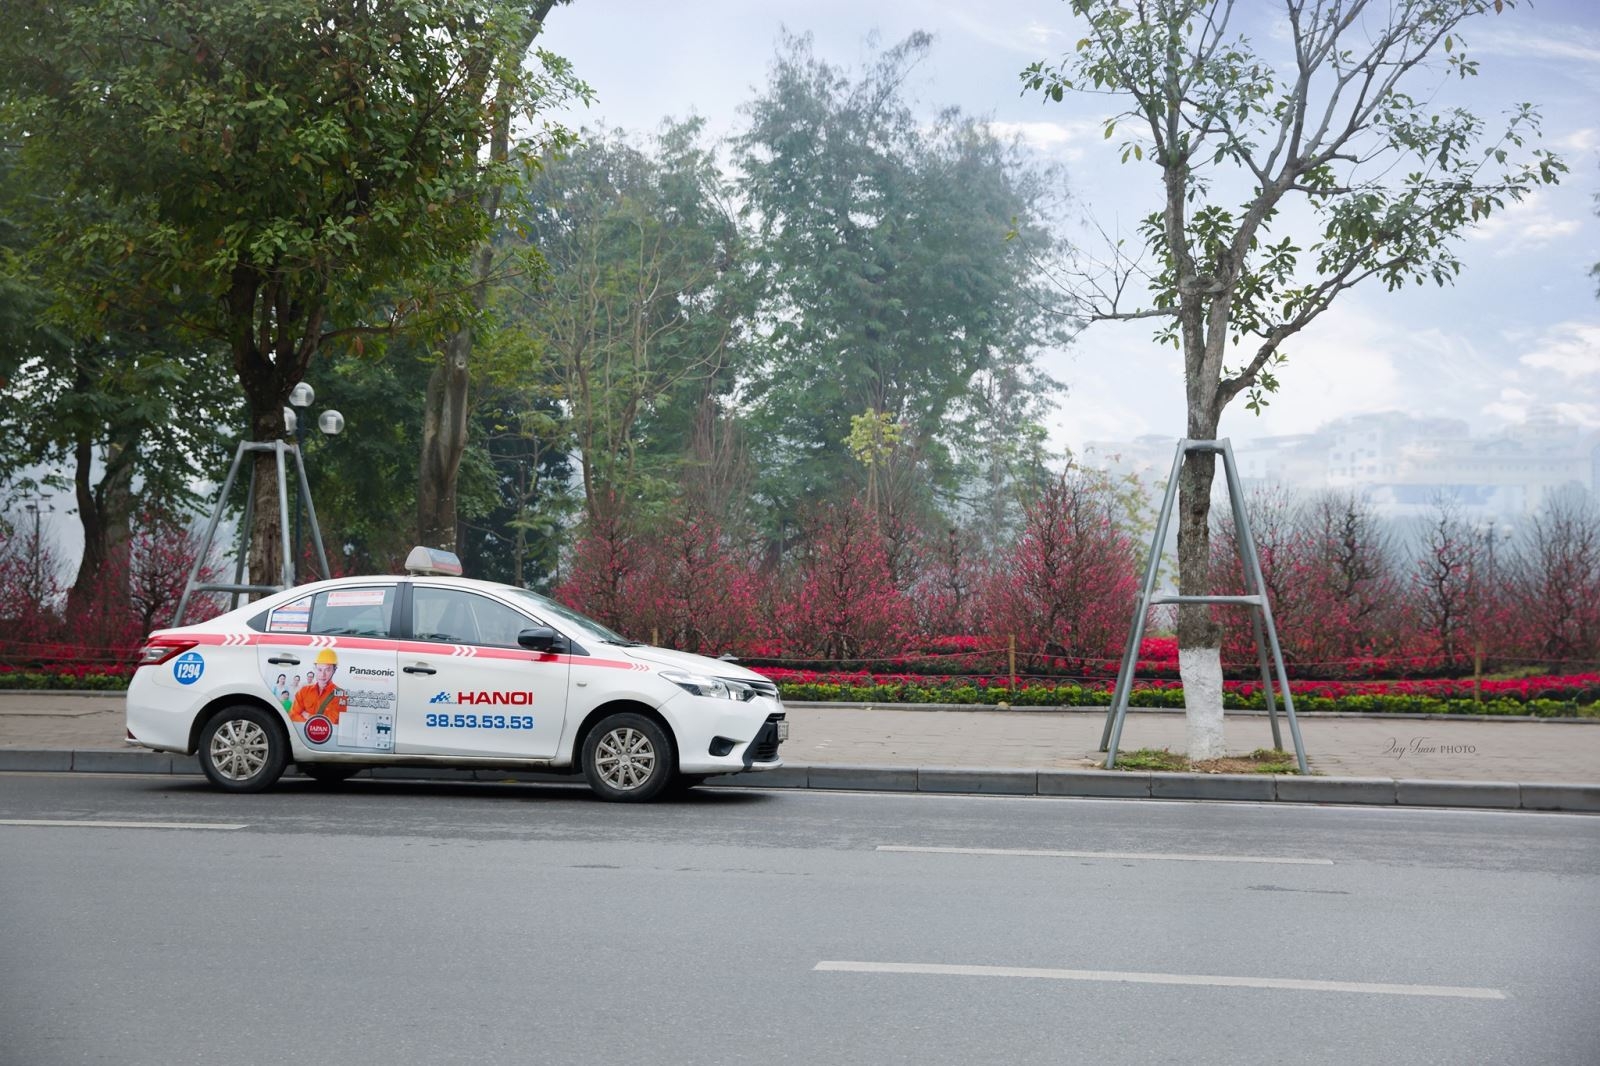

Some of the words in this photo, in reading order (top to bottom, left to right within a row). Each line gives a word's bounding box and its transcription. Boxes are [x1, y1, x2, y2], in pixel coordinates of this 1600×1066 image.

[178, 664, 200, 678] 1294
[349, 666, 395, 676] Panasonic
[458, 691, 533, 705] HANOI
[426, 714, 534, 729] 38.53.53.53
